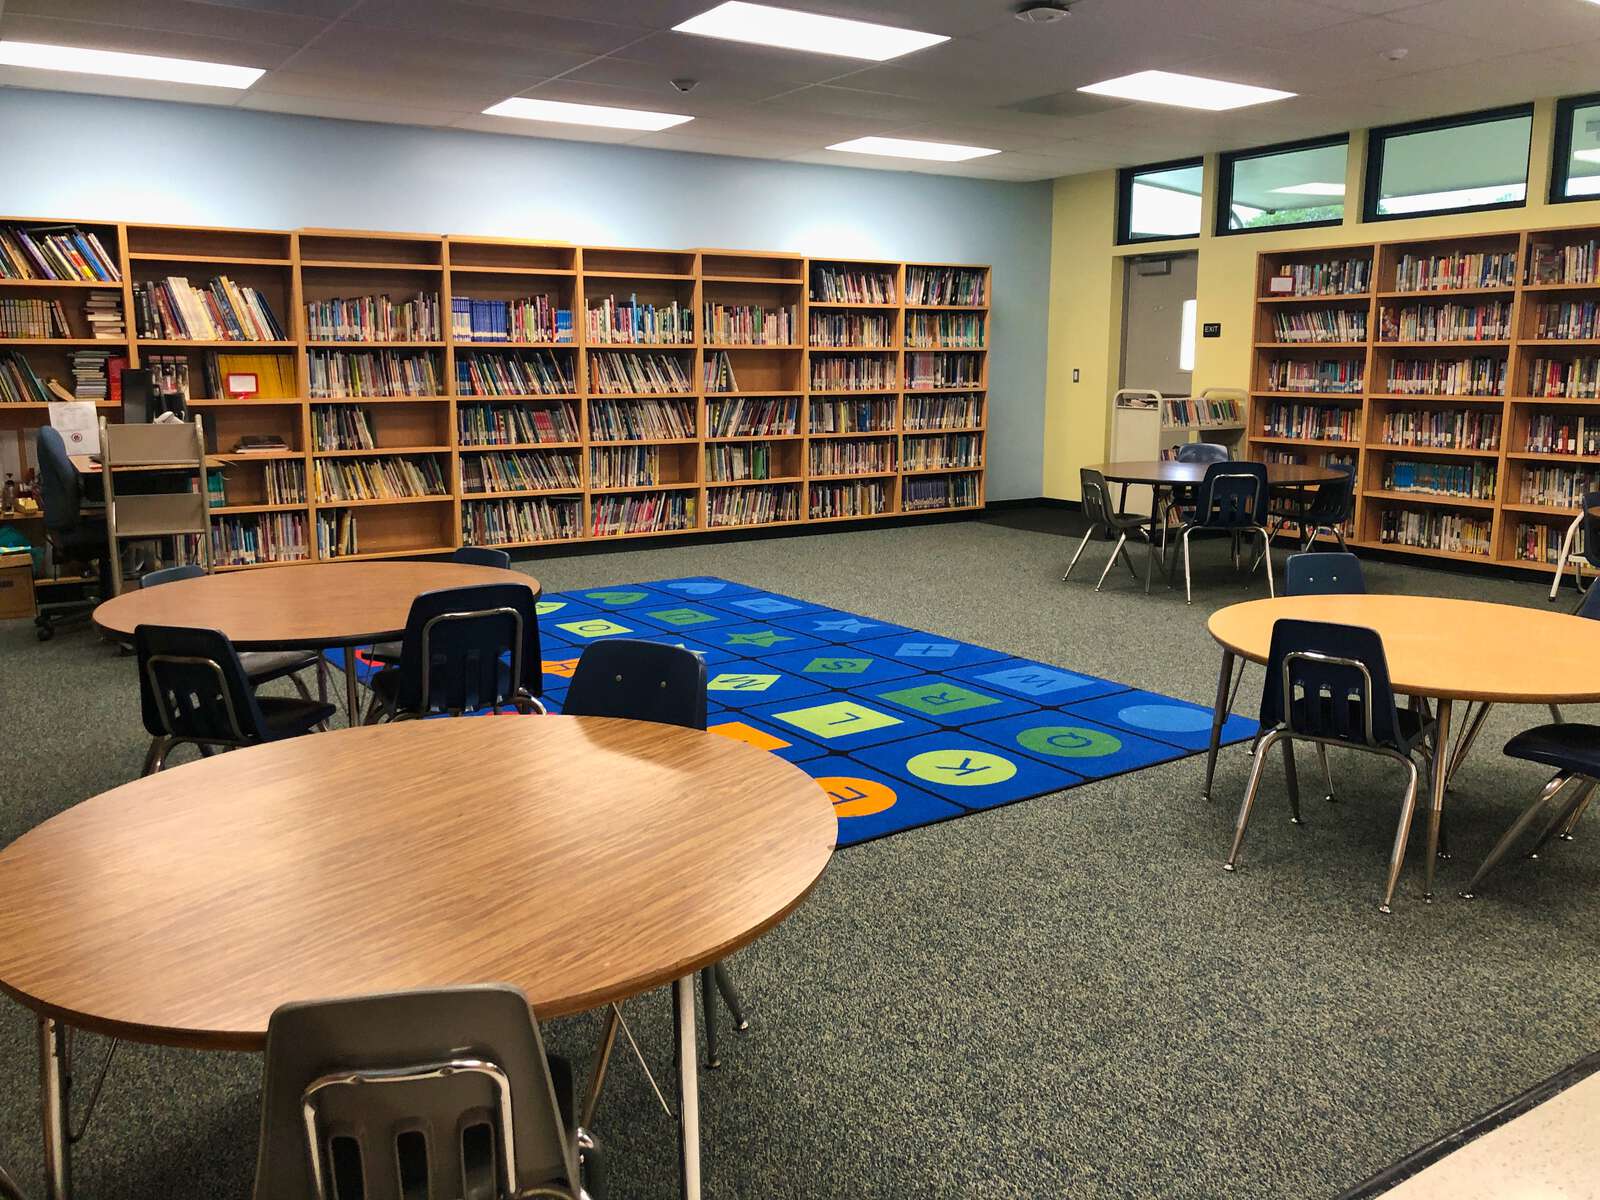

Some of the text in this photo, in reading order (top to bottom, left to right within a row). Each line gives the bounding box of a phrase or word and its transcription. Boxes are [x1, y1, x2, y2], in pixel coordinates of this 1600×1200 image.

[1204, 325, 1219, 333] EXIT
[664, 612, 699, 621] U
[578, 624, 611, 632] O
[821, 659, 857, 671] S
[920, 691, 966, 706] R
[827, 712, 862, 725] L
[1046, 732, 1092, 749] Q
[935, 757, 992, 777] K
